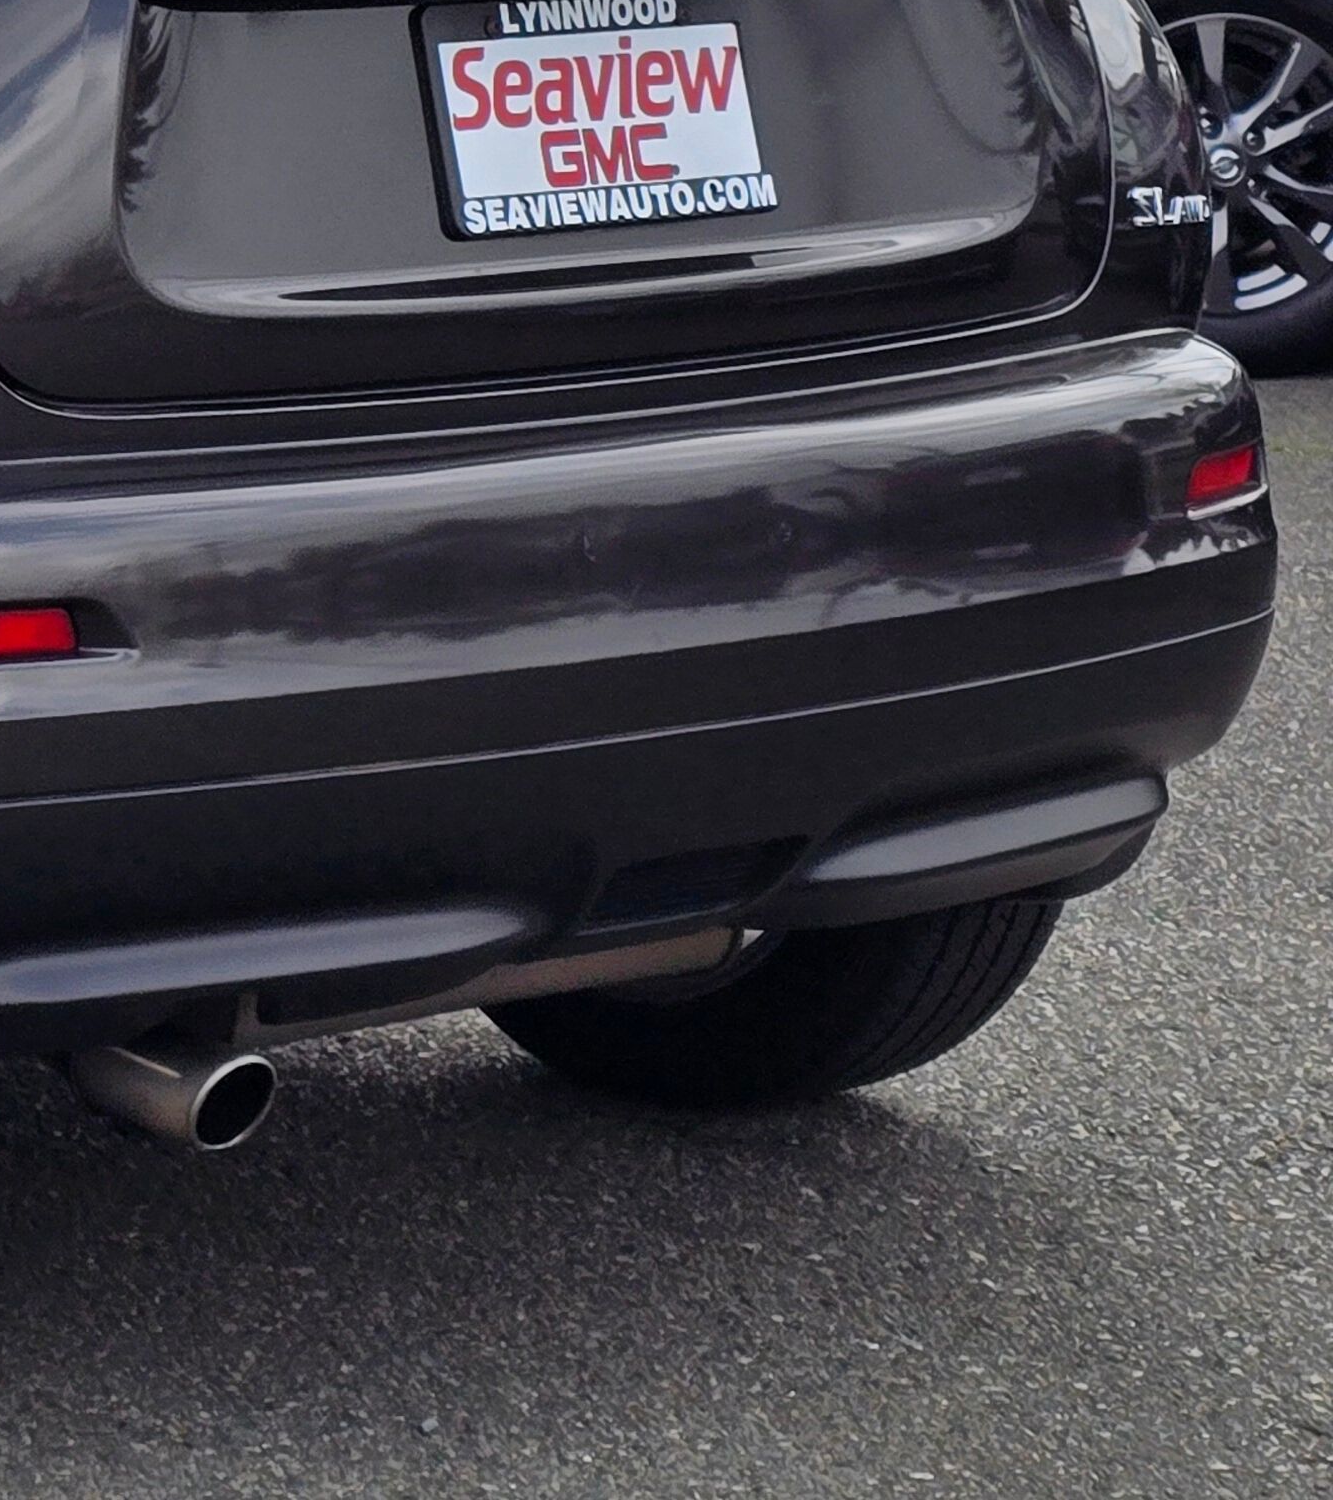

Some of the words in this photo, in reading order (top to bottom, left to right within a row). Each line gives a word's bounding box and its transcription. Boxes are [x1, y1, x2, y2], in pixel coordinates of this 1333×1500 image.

[451, 36, 738, 131] Seaview
[540, 123, 675, 188] GMC
[462, 174, 778, 235] SEAVIEWAUTO.COM
